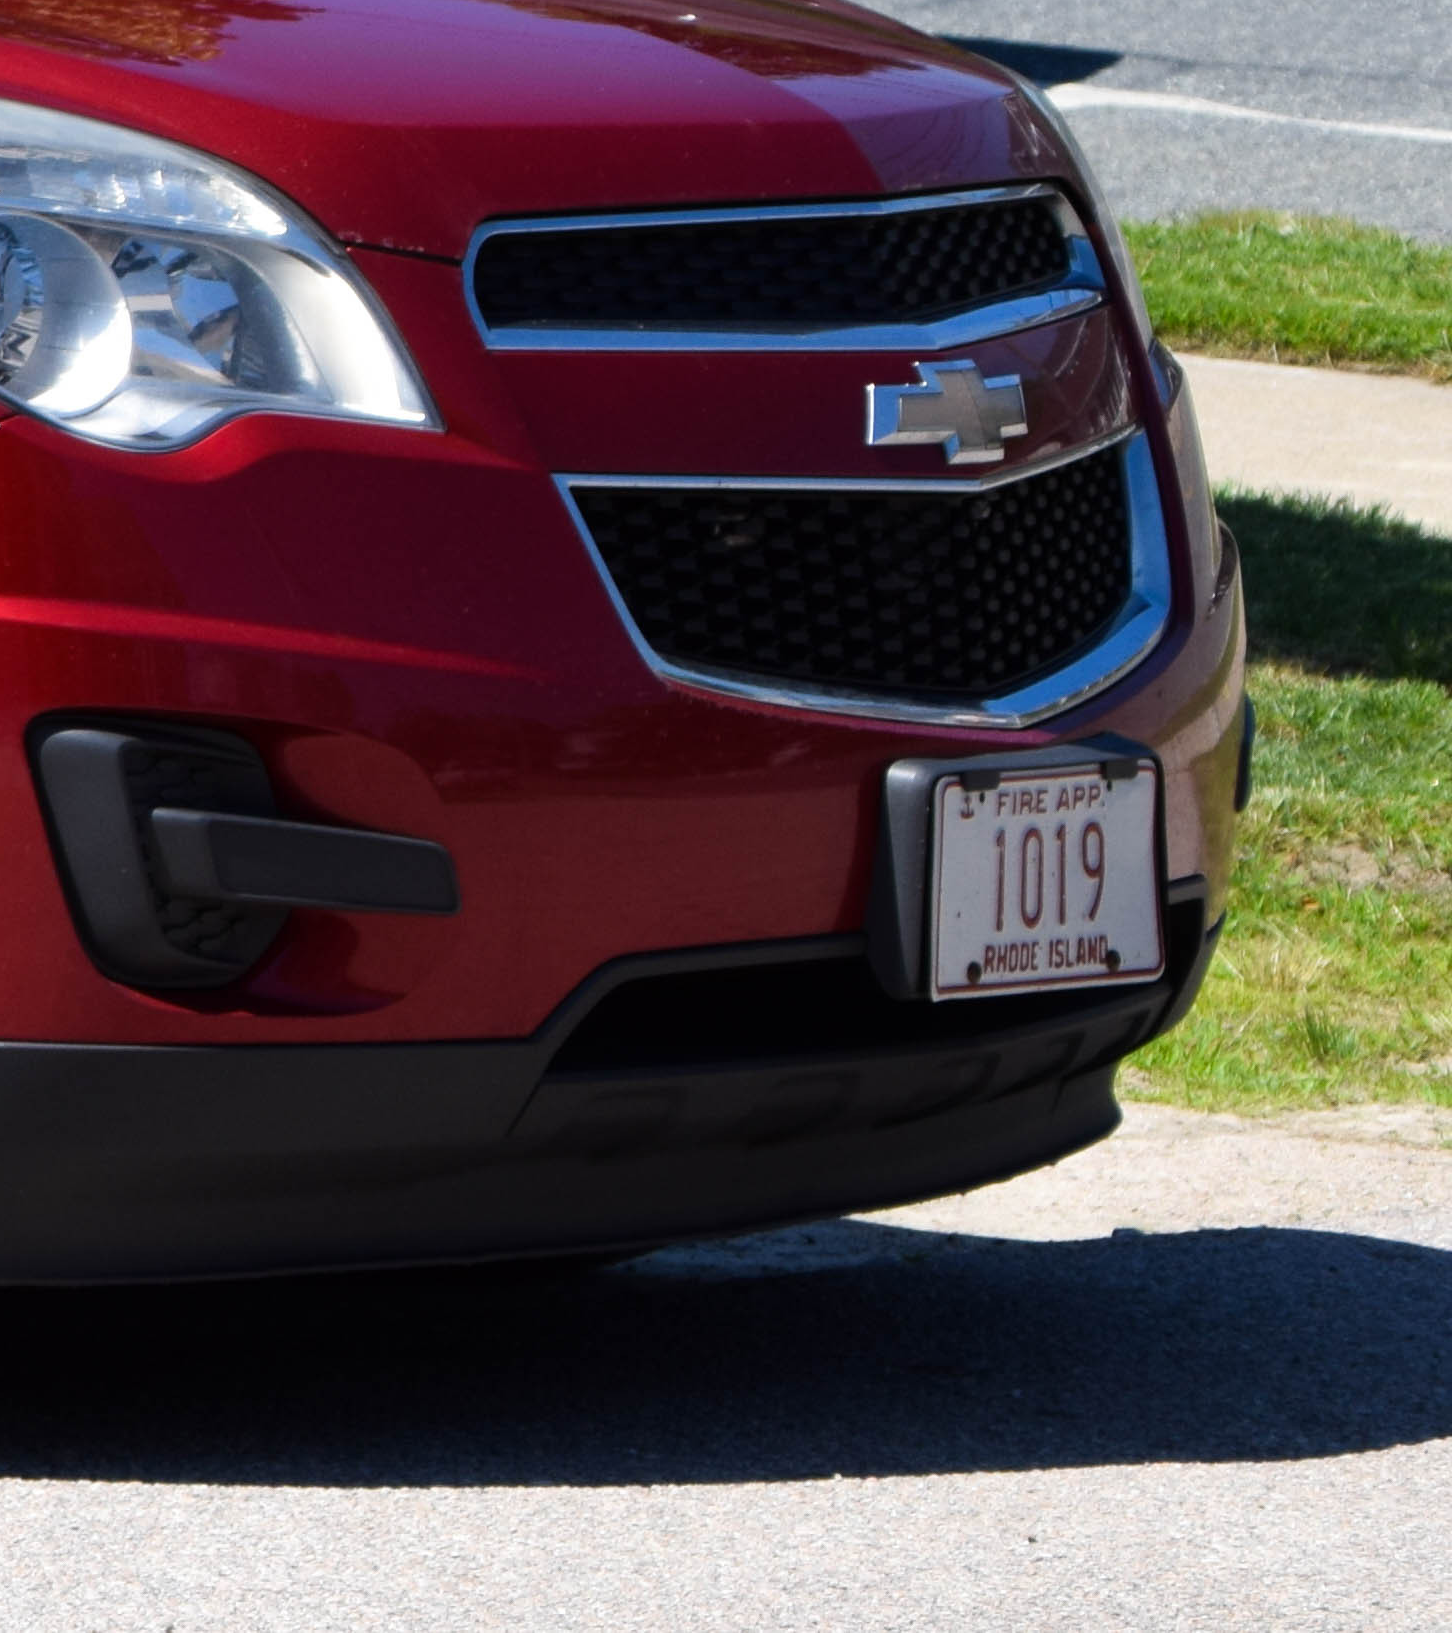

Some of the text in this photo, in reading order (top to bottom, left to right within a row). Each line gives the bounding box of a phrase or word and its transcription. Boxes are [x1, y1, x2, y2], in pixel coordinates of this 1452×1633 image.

[996, 789, 1049, 817] FIRE
[995, 821, 1106, 933] 1019
[983, 934, 1109, 975] RHODE ISLAND
